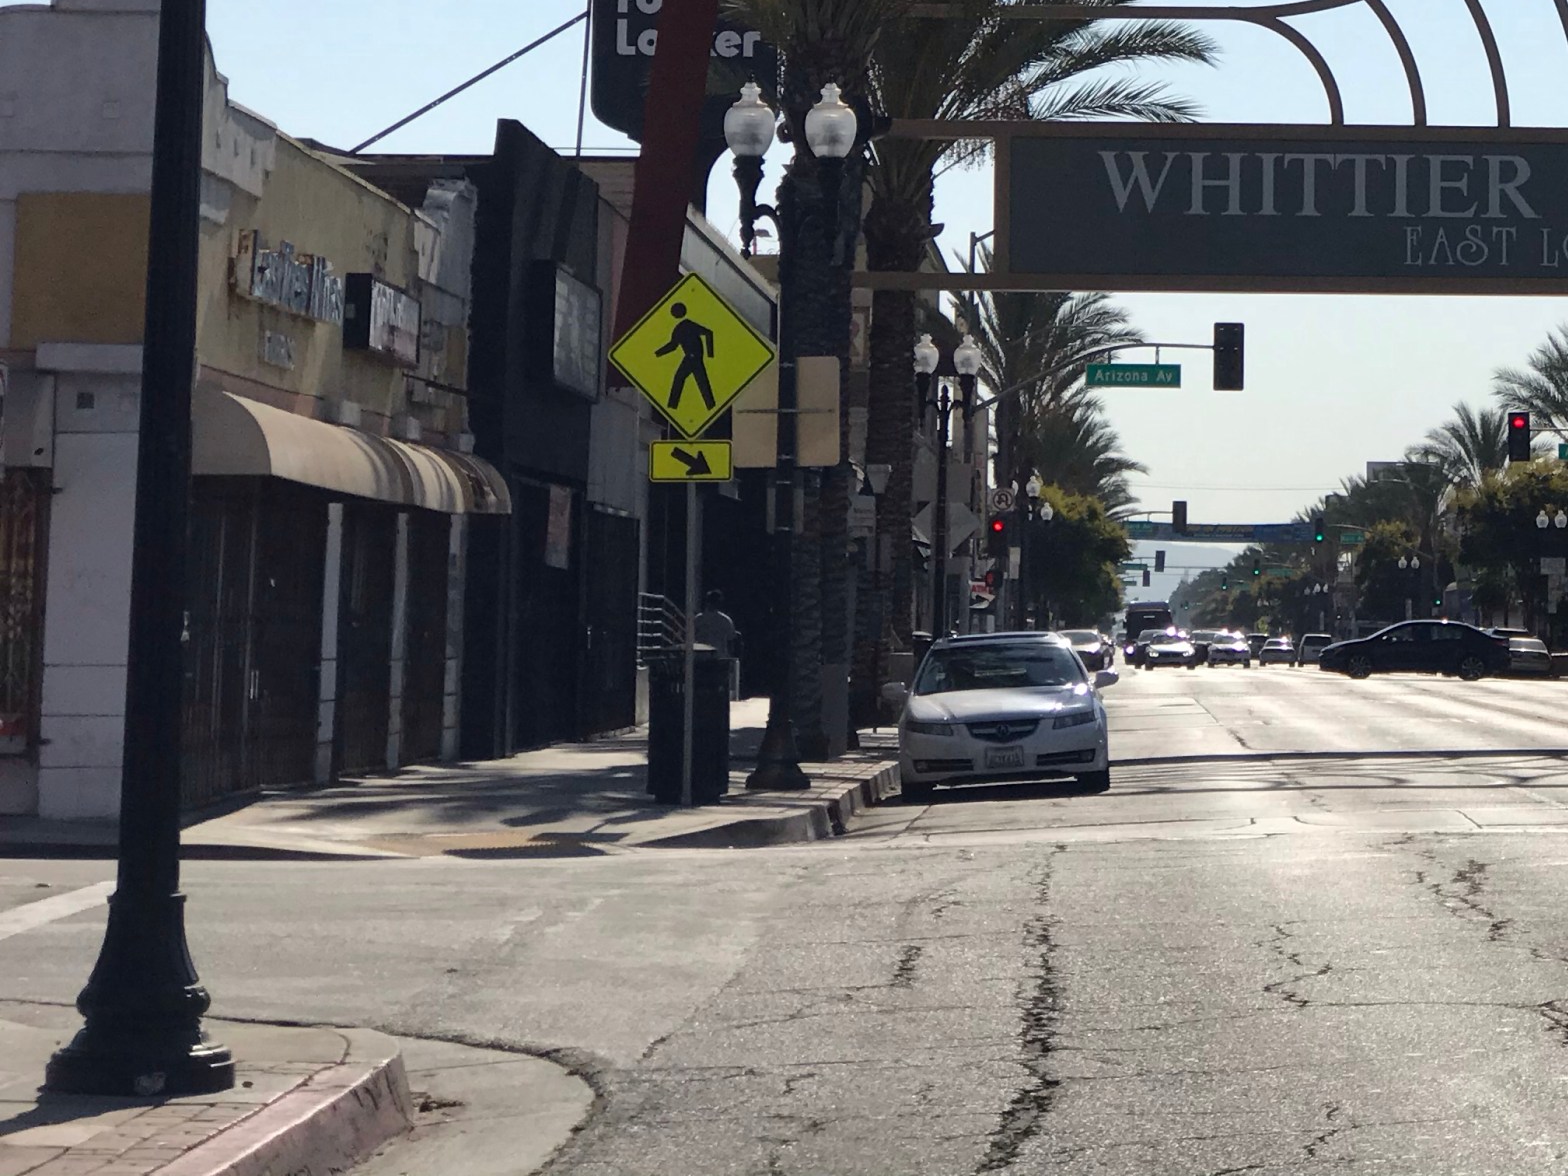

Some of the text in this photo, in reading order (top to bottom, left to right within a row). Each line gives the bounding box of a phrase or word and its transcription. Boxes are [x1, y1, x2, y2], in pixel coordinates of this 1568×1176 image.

[616, 18, 761, 58] Loer
[1097, 150, 1542, 219] WHITTIER
[1404, 224, 1517, 267] EAST
[1095, 369, 1172, 383] Arizona Av
